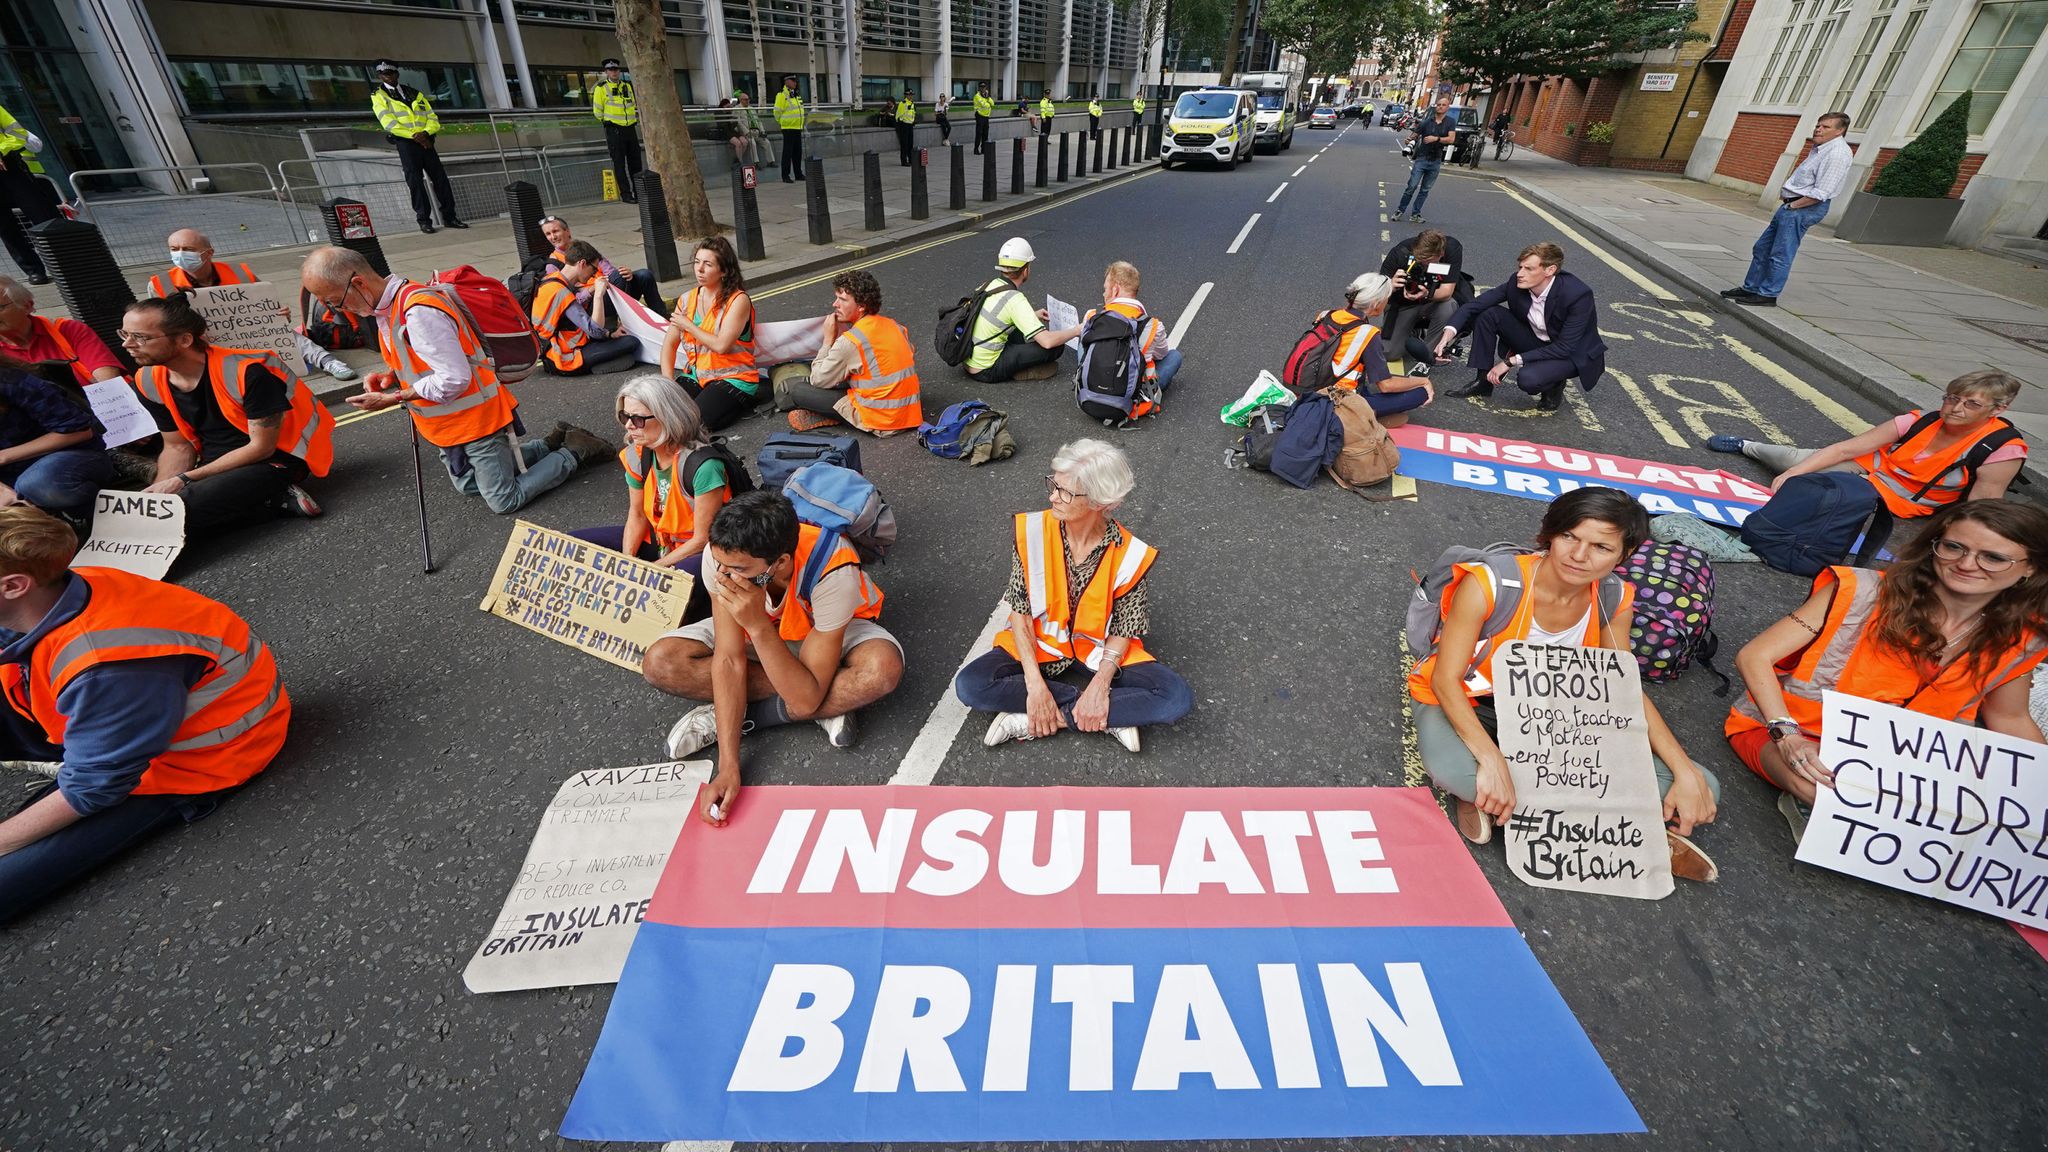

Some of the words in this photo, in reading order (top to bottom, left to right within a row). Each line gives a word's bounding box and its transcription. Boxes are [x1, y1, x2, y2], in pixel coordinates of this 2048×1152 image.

[208, 287, 249, 304] Nick
[234, 323, 293, 340] investment
[98, 494, 174, 520] JAMES
[82, 539, 178, 561] ARCHITECT
[522, 528, 588, 563] JANINE
[591, 551, 674, 594] EAGLING
[506, 565, 538, 585] BEST
[536, 575, 612, 616] INVESTMENT
[613, 603, 632, 624] TO
[513, 547, 550, 574] BIKE
[550, 560, 651, 613] INSTRUCTOR
[502, 580, 545, 607] REDUCE
[545, 596, 573, 618] CO2
[587, 629, 648, 667] BRITAIN
[1505, 642, 1625, 677] STEFANIA
[1509, 669, 1610, 703] MOROSI
[1573, 705, 1632, 731] teacher
[1536, 725, 1602, 747] Mother
[1837, 709, 1870, 749] I
[1889, 719, 2035, 787] WANT
[572, 763, 686, 788] XAVIER
[1515, 749, 1554, 766] end
[1560, 749, 1603, 777] fuel
[553, 784, 688, 808] GONZALEZ
[1535, 765, 1610, 799] Poverty
[549, 807, 632, 825] TRIMMER
[519, 859, 578, 884] BEST
[585, 853, 666, 874] INVESTMENT
[746, 808, 1400, 897] INSULATE
[1523, 839, 1645, 882] Britain
[1832, 814, 1902, 866] TO
[1903, 840, 2048, 921] SURVI
[514, 887, 537, 902] TO
[482, 931, 584, 957] BRITAIN
[726, 961, 1464, 1093] BRITAIN
